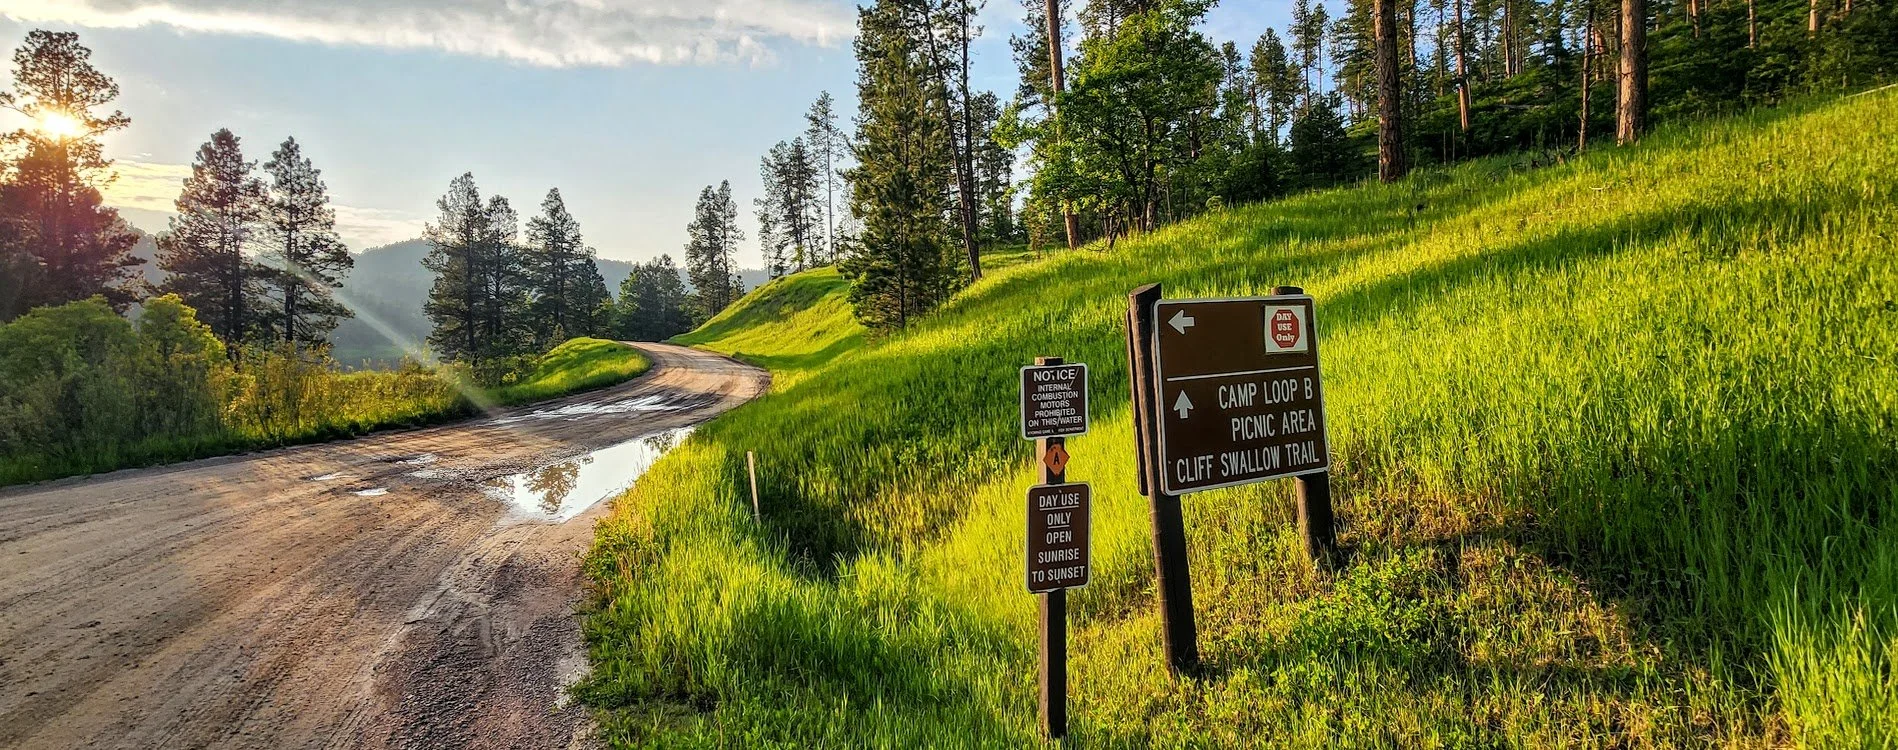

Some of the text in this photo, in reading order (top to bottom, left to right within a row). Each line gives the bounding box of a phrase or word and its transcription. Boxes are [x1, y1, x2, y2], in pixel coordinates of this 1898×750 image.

[1276, 312, 1292, 321] DAY
[1277, 323, 1292, 331] USE
[1276, 333, 1295, 343] Only
[1033, 369, 1075, 382] NOTICE
[1038, 383, 1071, 392] INTERNAL
[1218, 377, 1313, 409] CAMP LOOP B
[1031, 391, 1078, 401] COMBUSTION
[1040, 400, 1070, 409] MOTORS
[1034, 408, 1076, 418] PROHIBITED
[1028, 415, 1083, 427] ON THIS WATER
[1231, 409, 1317, 442] PICNIC AREA
[1053, 452, 1060, 466] A
[1176, 440, 1320, 484] CLIFF SWALLOW TRAIL
[1039, 493, 1080, 508] DAY USE
[1047, 512, 1072, 525] ONLY
[1046, 530, 1072, 545] OPEN
[1038, 548, 1080, 564] SUNRISE
[1032, 565, 1085, 583] TO SUNSET
